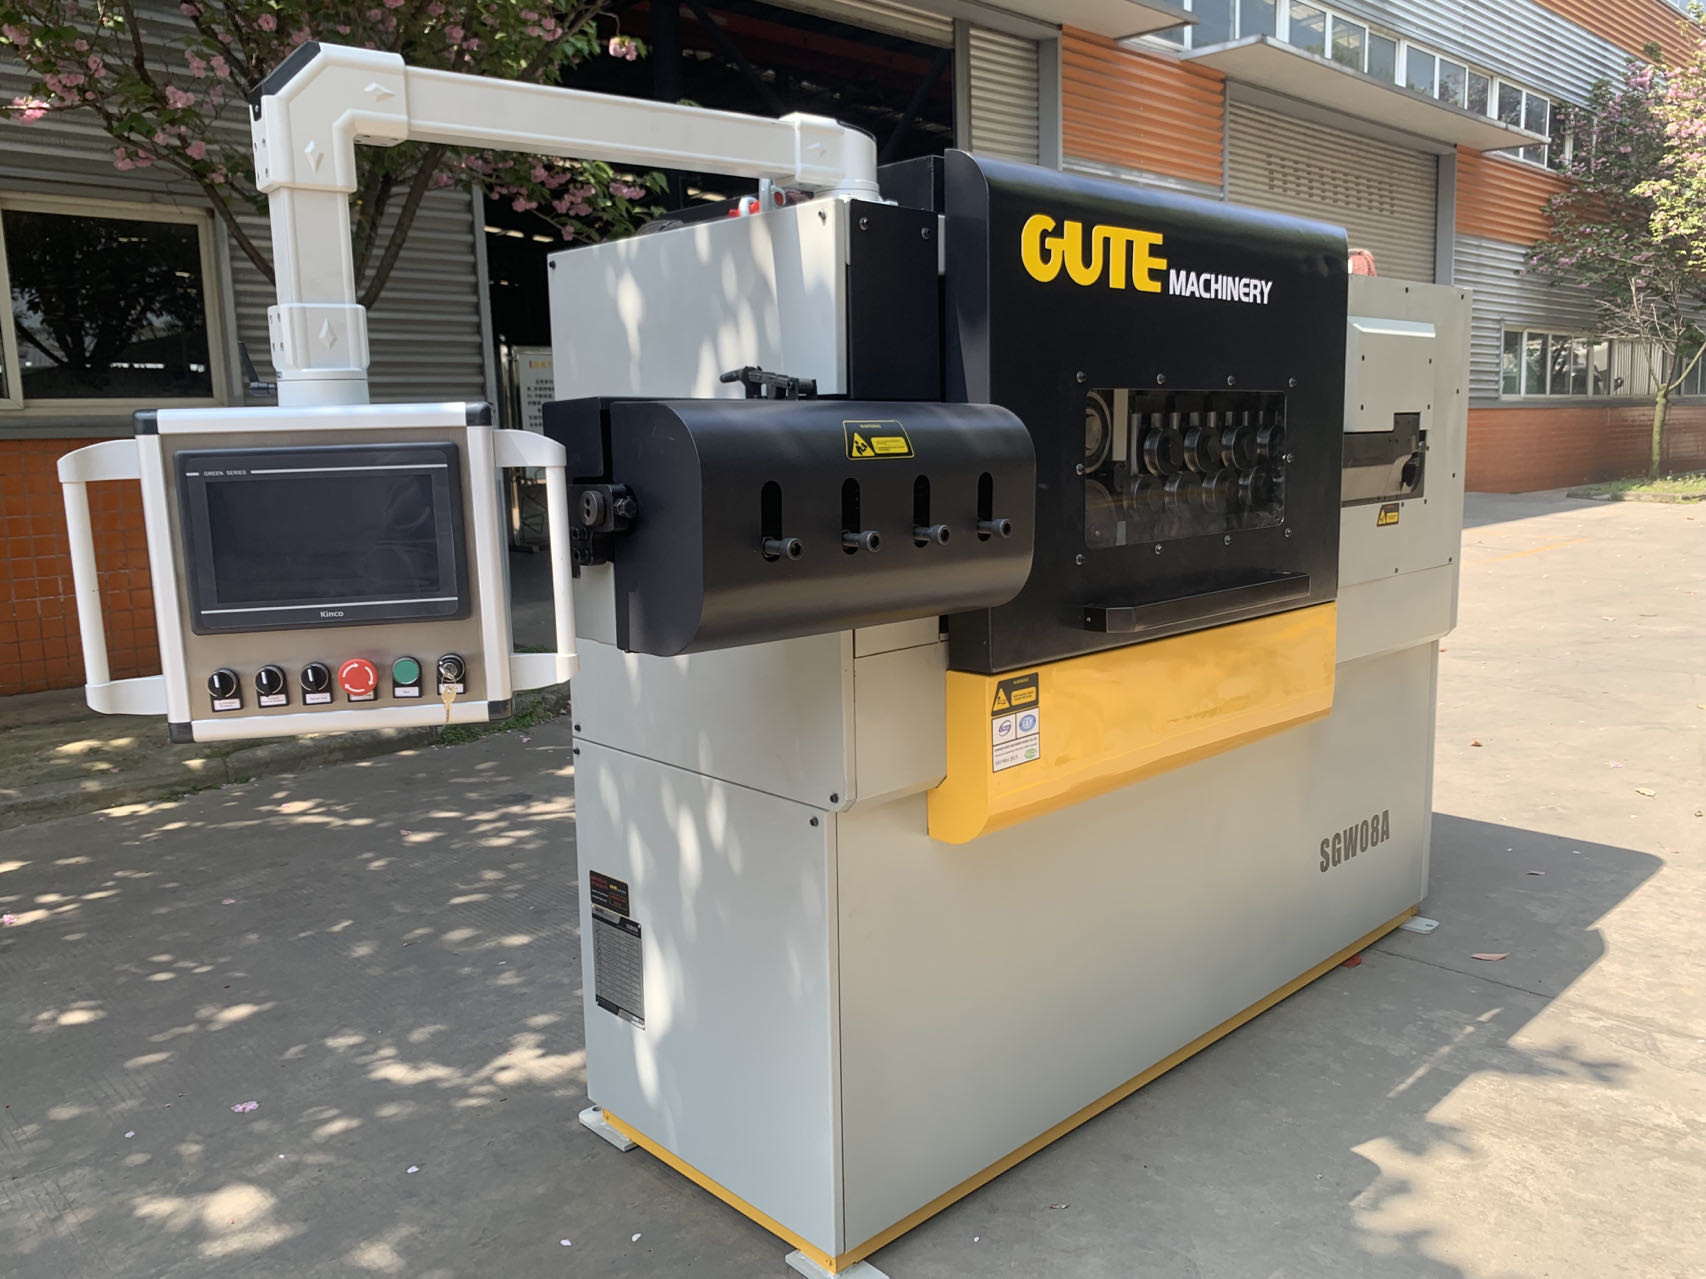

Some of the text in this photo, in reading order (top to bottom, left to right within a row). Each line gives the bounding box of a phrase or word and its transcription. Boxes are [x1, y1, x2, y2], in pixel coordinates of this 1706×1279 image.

[1021, 214, 1168, 293] GUTE
[1169, 269, 1273, 305] MACHINERY
[320, 610, 344, 618] Kinco
[1320, 809, 1390, 873] SGW08A
